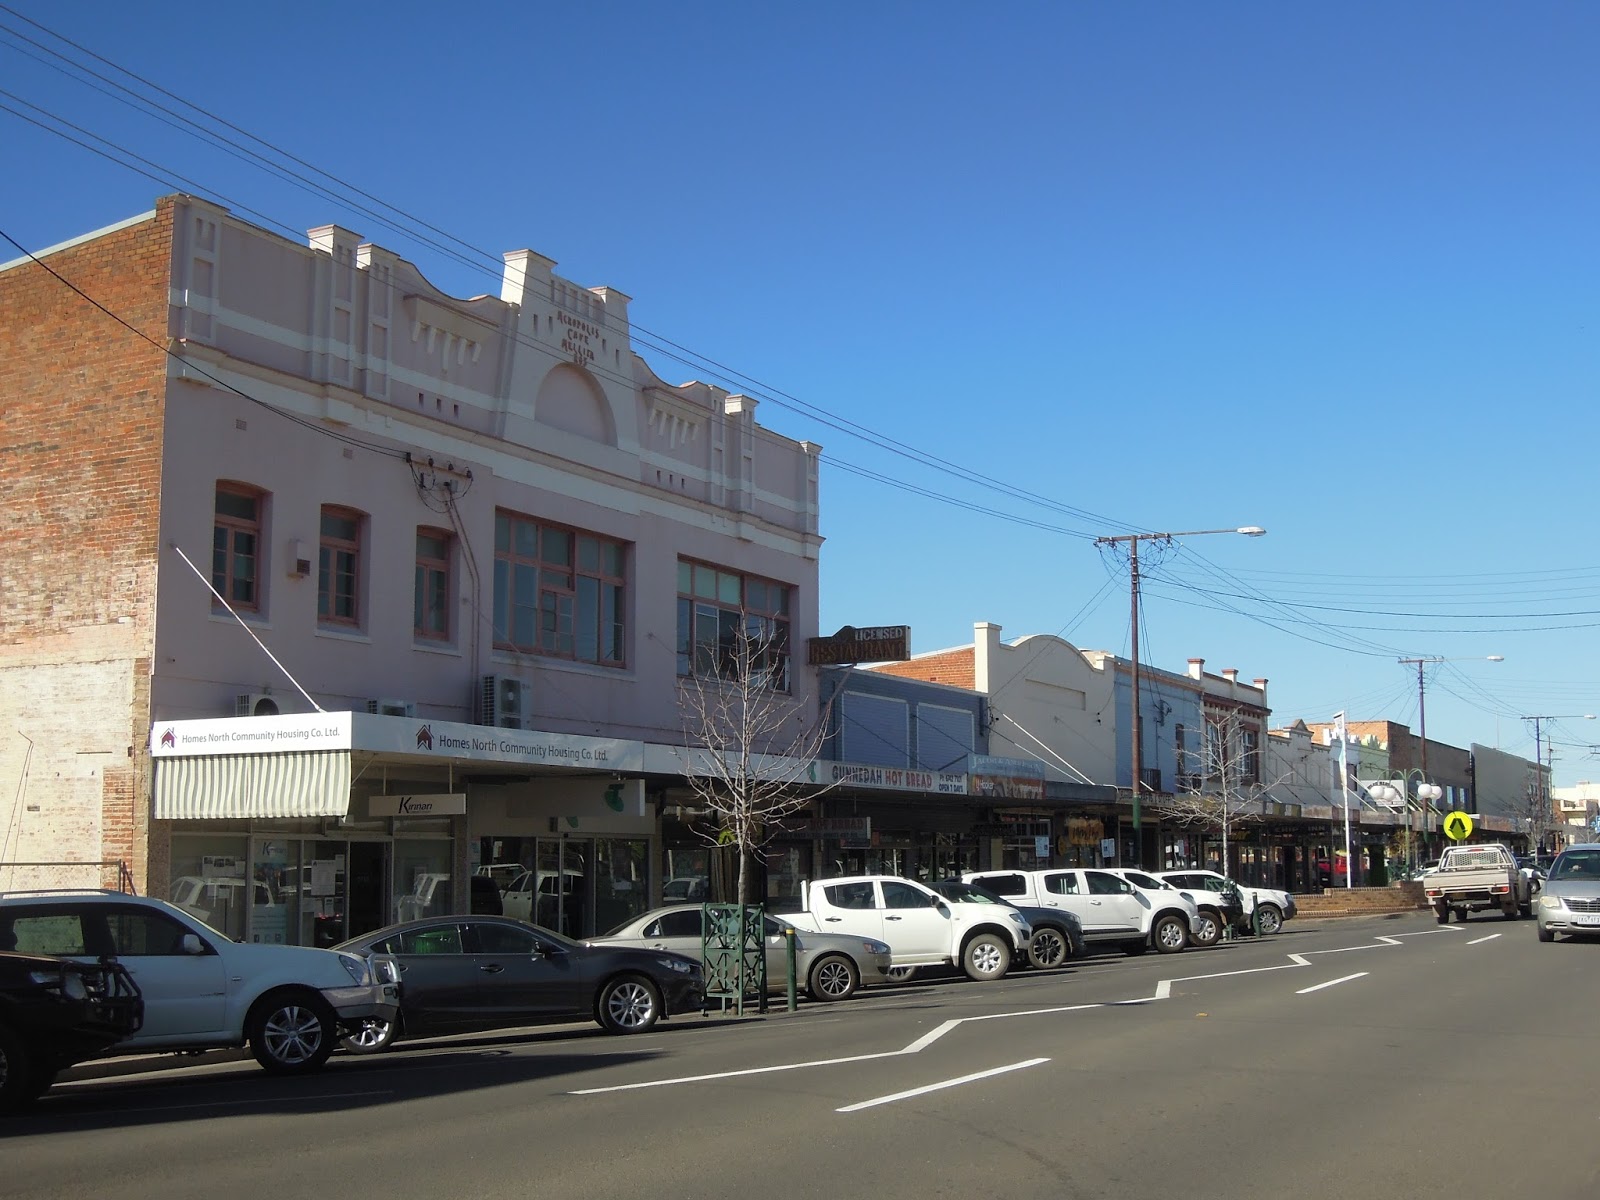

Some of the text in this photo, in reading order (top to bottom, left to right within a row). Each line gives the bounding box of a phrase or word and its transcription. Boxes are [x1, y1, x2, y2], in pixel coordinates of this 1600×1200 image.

[567, 328, 589, 345] CAFE
[854, 627, 903, 641] LICENSED
[811, 641, 905, 662] RESTAURANT
[182, 726, 340, 744] Homes North Community Housing Co. Ltd.
[439, 734, 608, 761] Homes North Community Housing Co. Ltd.
[831, 765, 933, 789] GUNNEDAH HOT BREAD
